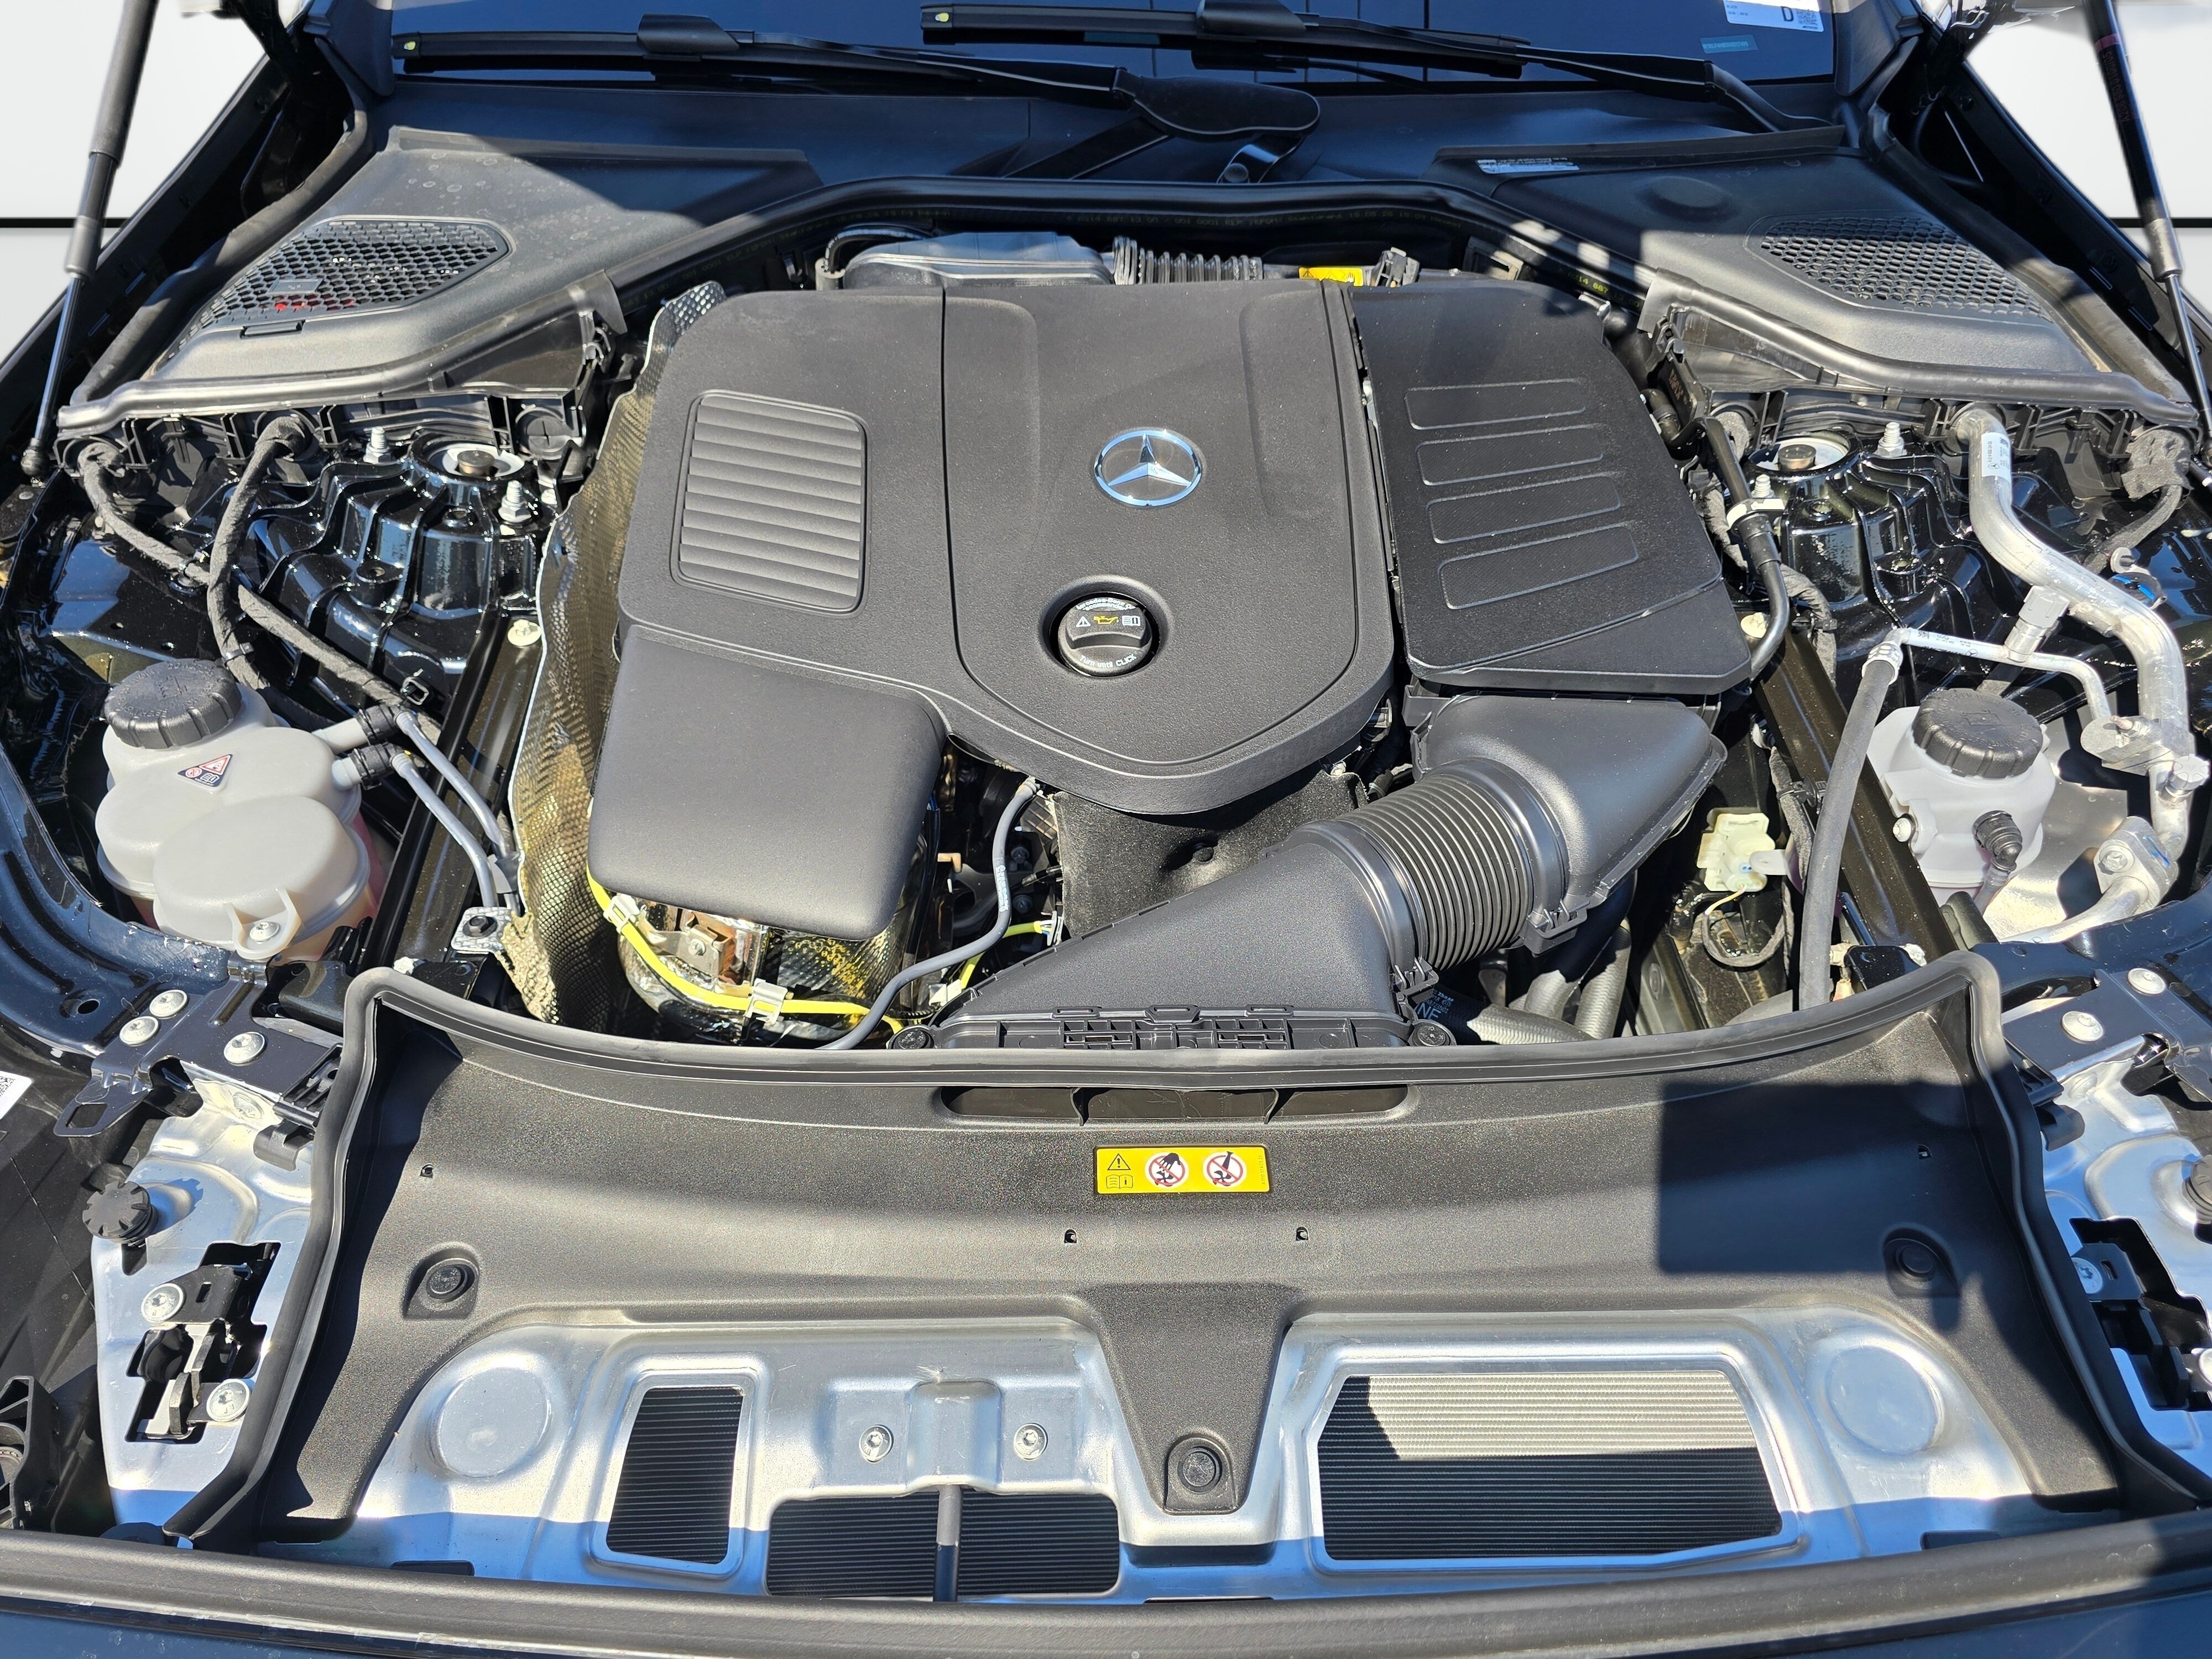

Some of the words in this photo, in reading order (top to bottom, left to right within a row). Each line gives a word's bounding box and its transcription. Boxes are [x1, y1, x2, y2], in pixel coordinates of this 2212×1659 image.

[1781, 6, 1793, 22] D
[1592, 282, 1609, 294] 887
[1080, 655, 1095, 667] Turn
[1115, 653, 1137, 666] CLICK
